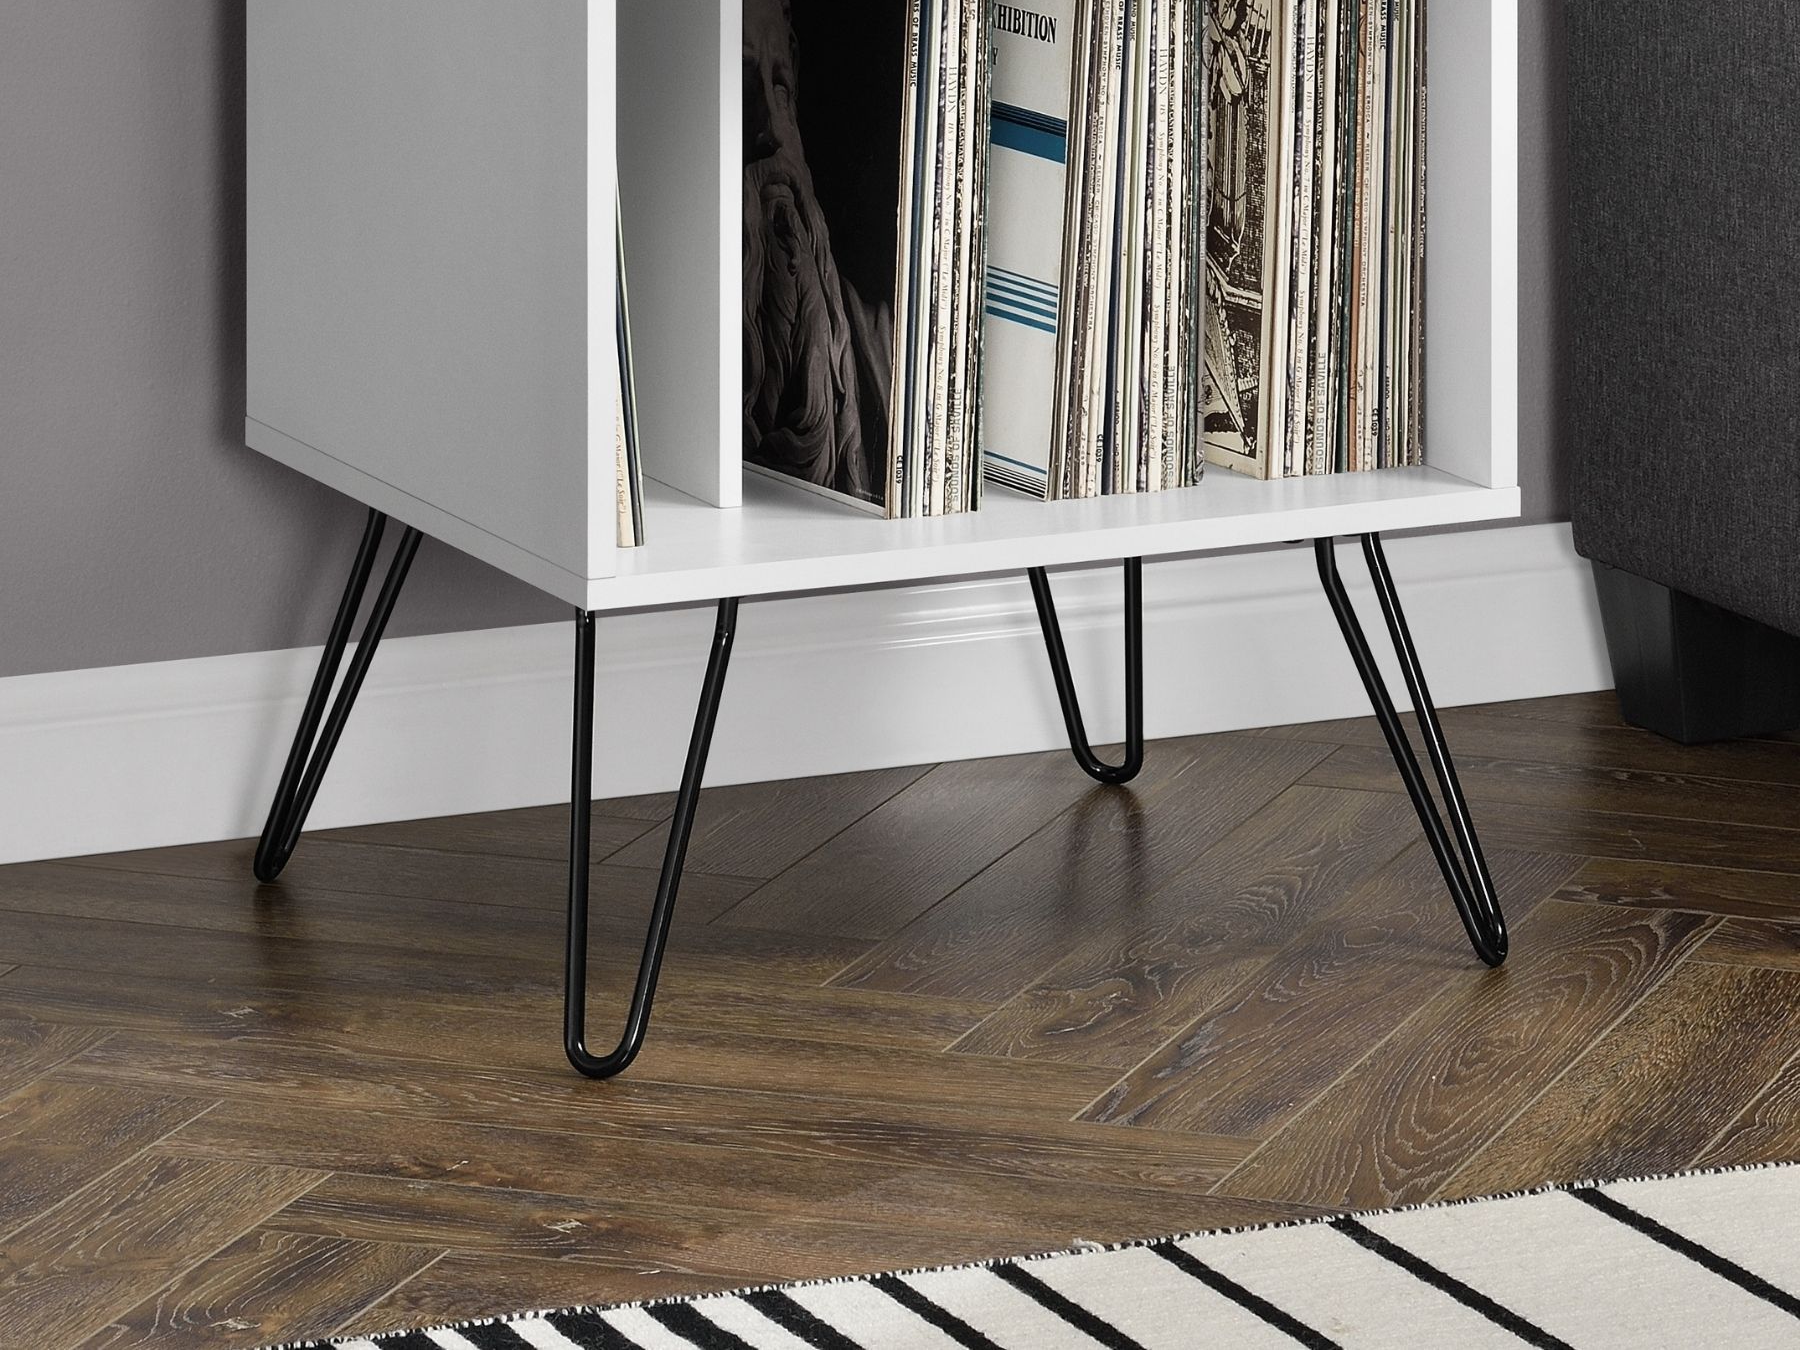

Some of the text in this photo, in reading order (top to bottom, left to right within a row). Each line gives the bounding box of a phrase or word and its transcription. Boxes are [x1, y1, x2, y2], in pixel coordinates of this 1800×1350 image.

[1118, 1, 1124, 12] OF
[912, 17, 919, 28] OF
[1159, 48, 1168, 95] HAYDN
[1306, 36, 1316, 83] HAYDN
[948, 67, 957, 113] HAYDN
[1302, 119, 1311, 159] Symphony
[1157, 132, 1165, 171] Symphony
[944, 151, 953, 191] Symphony
[1301, 204, 1309, 227] Major
[942, 237, 950, 261] Major
[1297, 290, 1305, 329] Symphony
[1152, 304, 1160, 344] Symphony
[937, 325, 947, 365] Symphony
[1152, 347, 1160, 360] No.
[936, 370, 944, 383] No.
[1317, 353, 1326, 396] SAVILLE
[1167, 366, 1175, 409] SAVILLE
[1294, 375, 1302, 399] Major
[953, 389, 962, 432] SAVILLE
[1149, 390, 1157, 414] Major
[1317, 399, 1324, 413] OF
[1372, 408, 1378, 417] CE
[933, 413, 942, 436] Major
[1167, 413, 1174, 427] OF
[953, 437, 960, 450] OF
[1097, 434, 1103, 443] CE
[897, 455, 903, 465] CE
